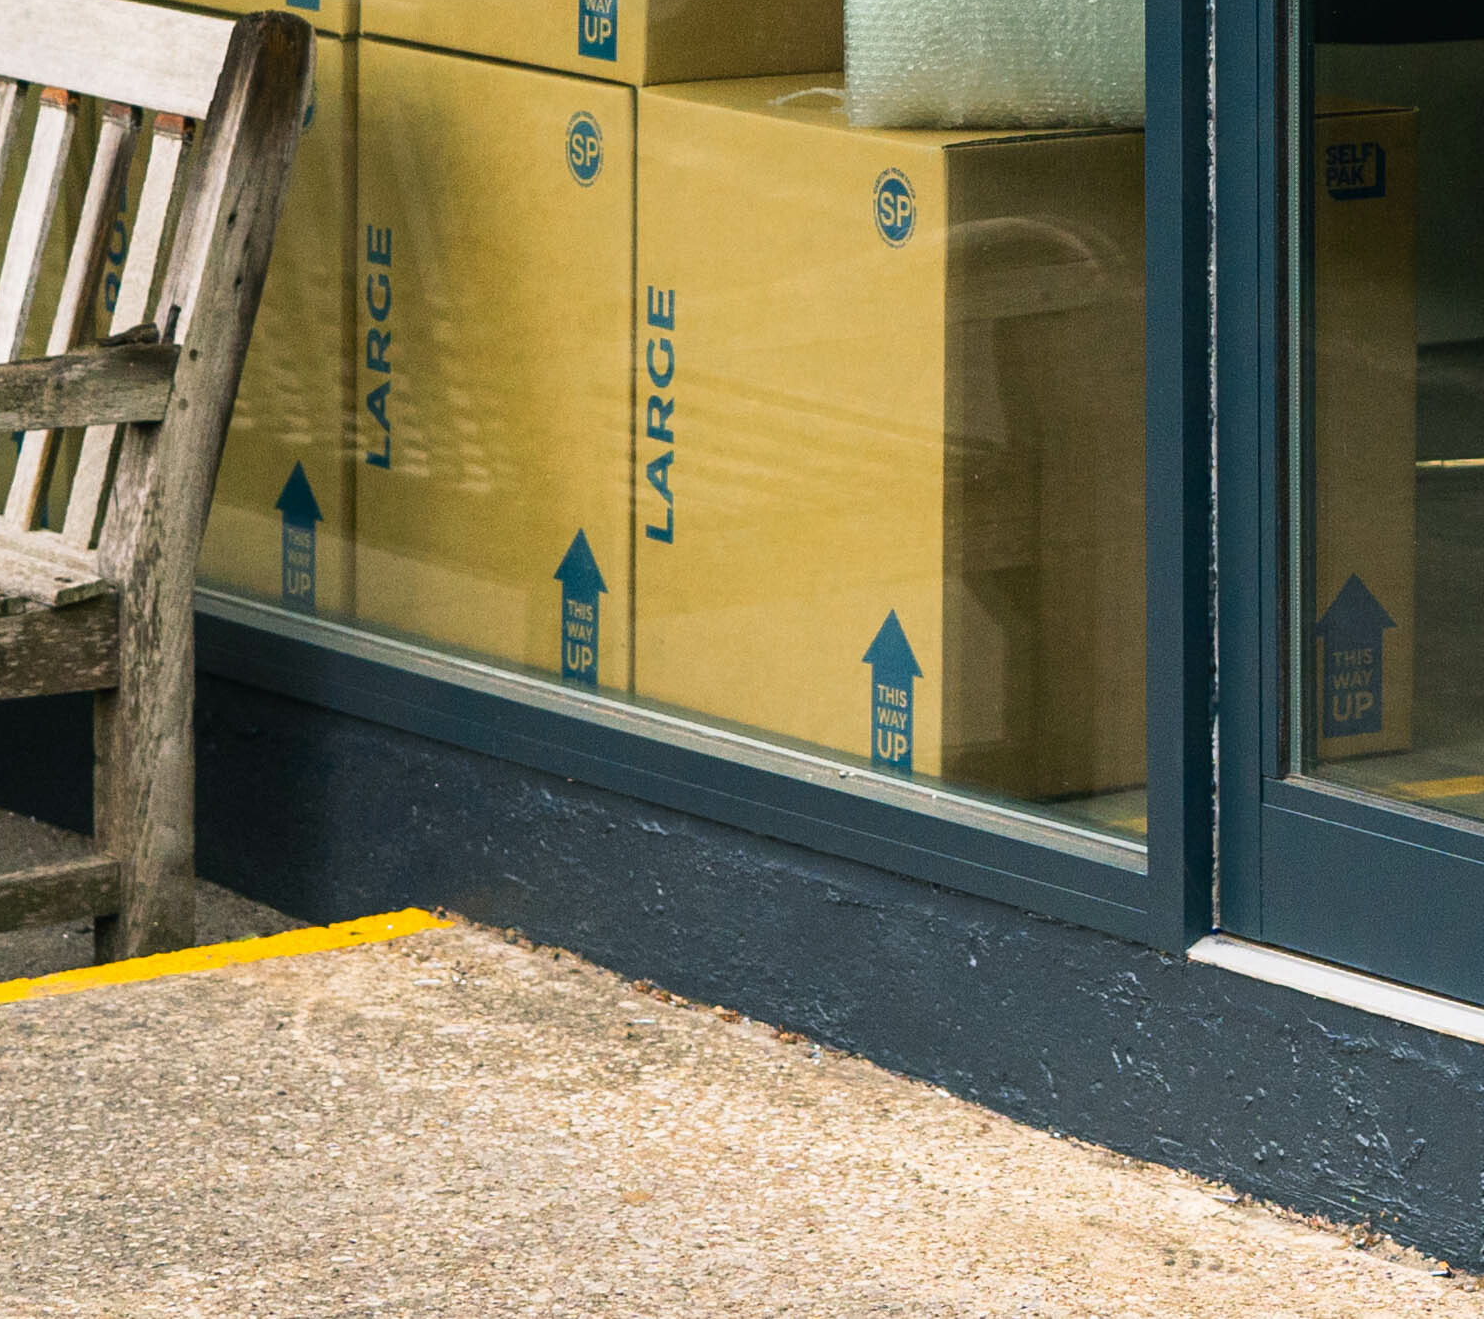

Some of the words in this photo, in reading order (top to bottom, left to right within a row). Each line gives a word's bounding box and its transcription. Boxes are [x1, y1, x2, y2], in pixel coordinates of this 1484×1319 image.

[583, 17, 612, 44] UP
[572, 134, 598, 166] SP
[1326, 143, 1376, 164] SELF
[1326, 165, 1365, 187] PAK
[880, 191, 910, 227] SP
[366, 224, 393, 470] LARGE
[646, 285, 675, 546] LARGE
[567, 600, 593, 621] THIS
[567, 623, 593, 643] WAY
[566, 644, 594, 671] UP
[1332, 649, 1374, 666] THIS
[1332, 668, 1373, 690] WAY
[878, 684, 909, 706] THIS
[878, 708, 909, 730] WAY
[1332, 693, 1375, 722] UP
[877, 732, 909, 762] UP
